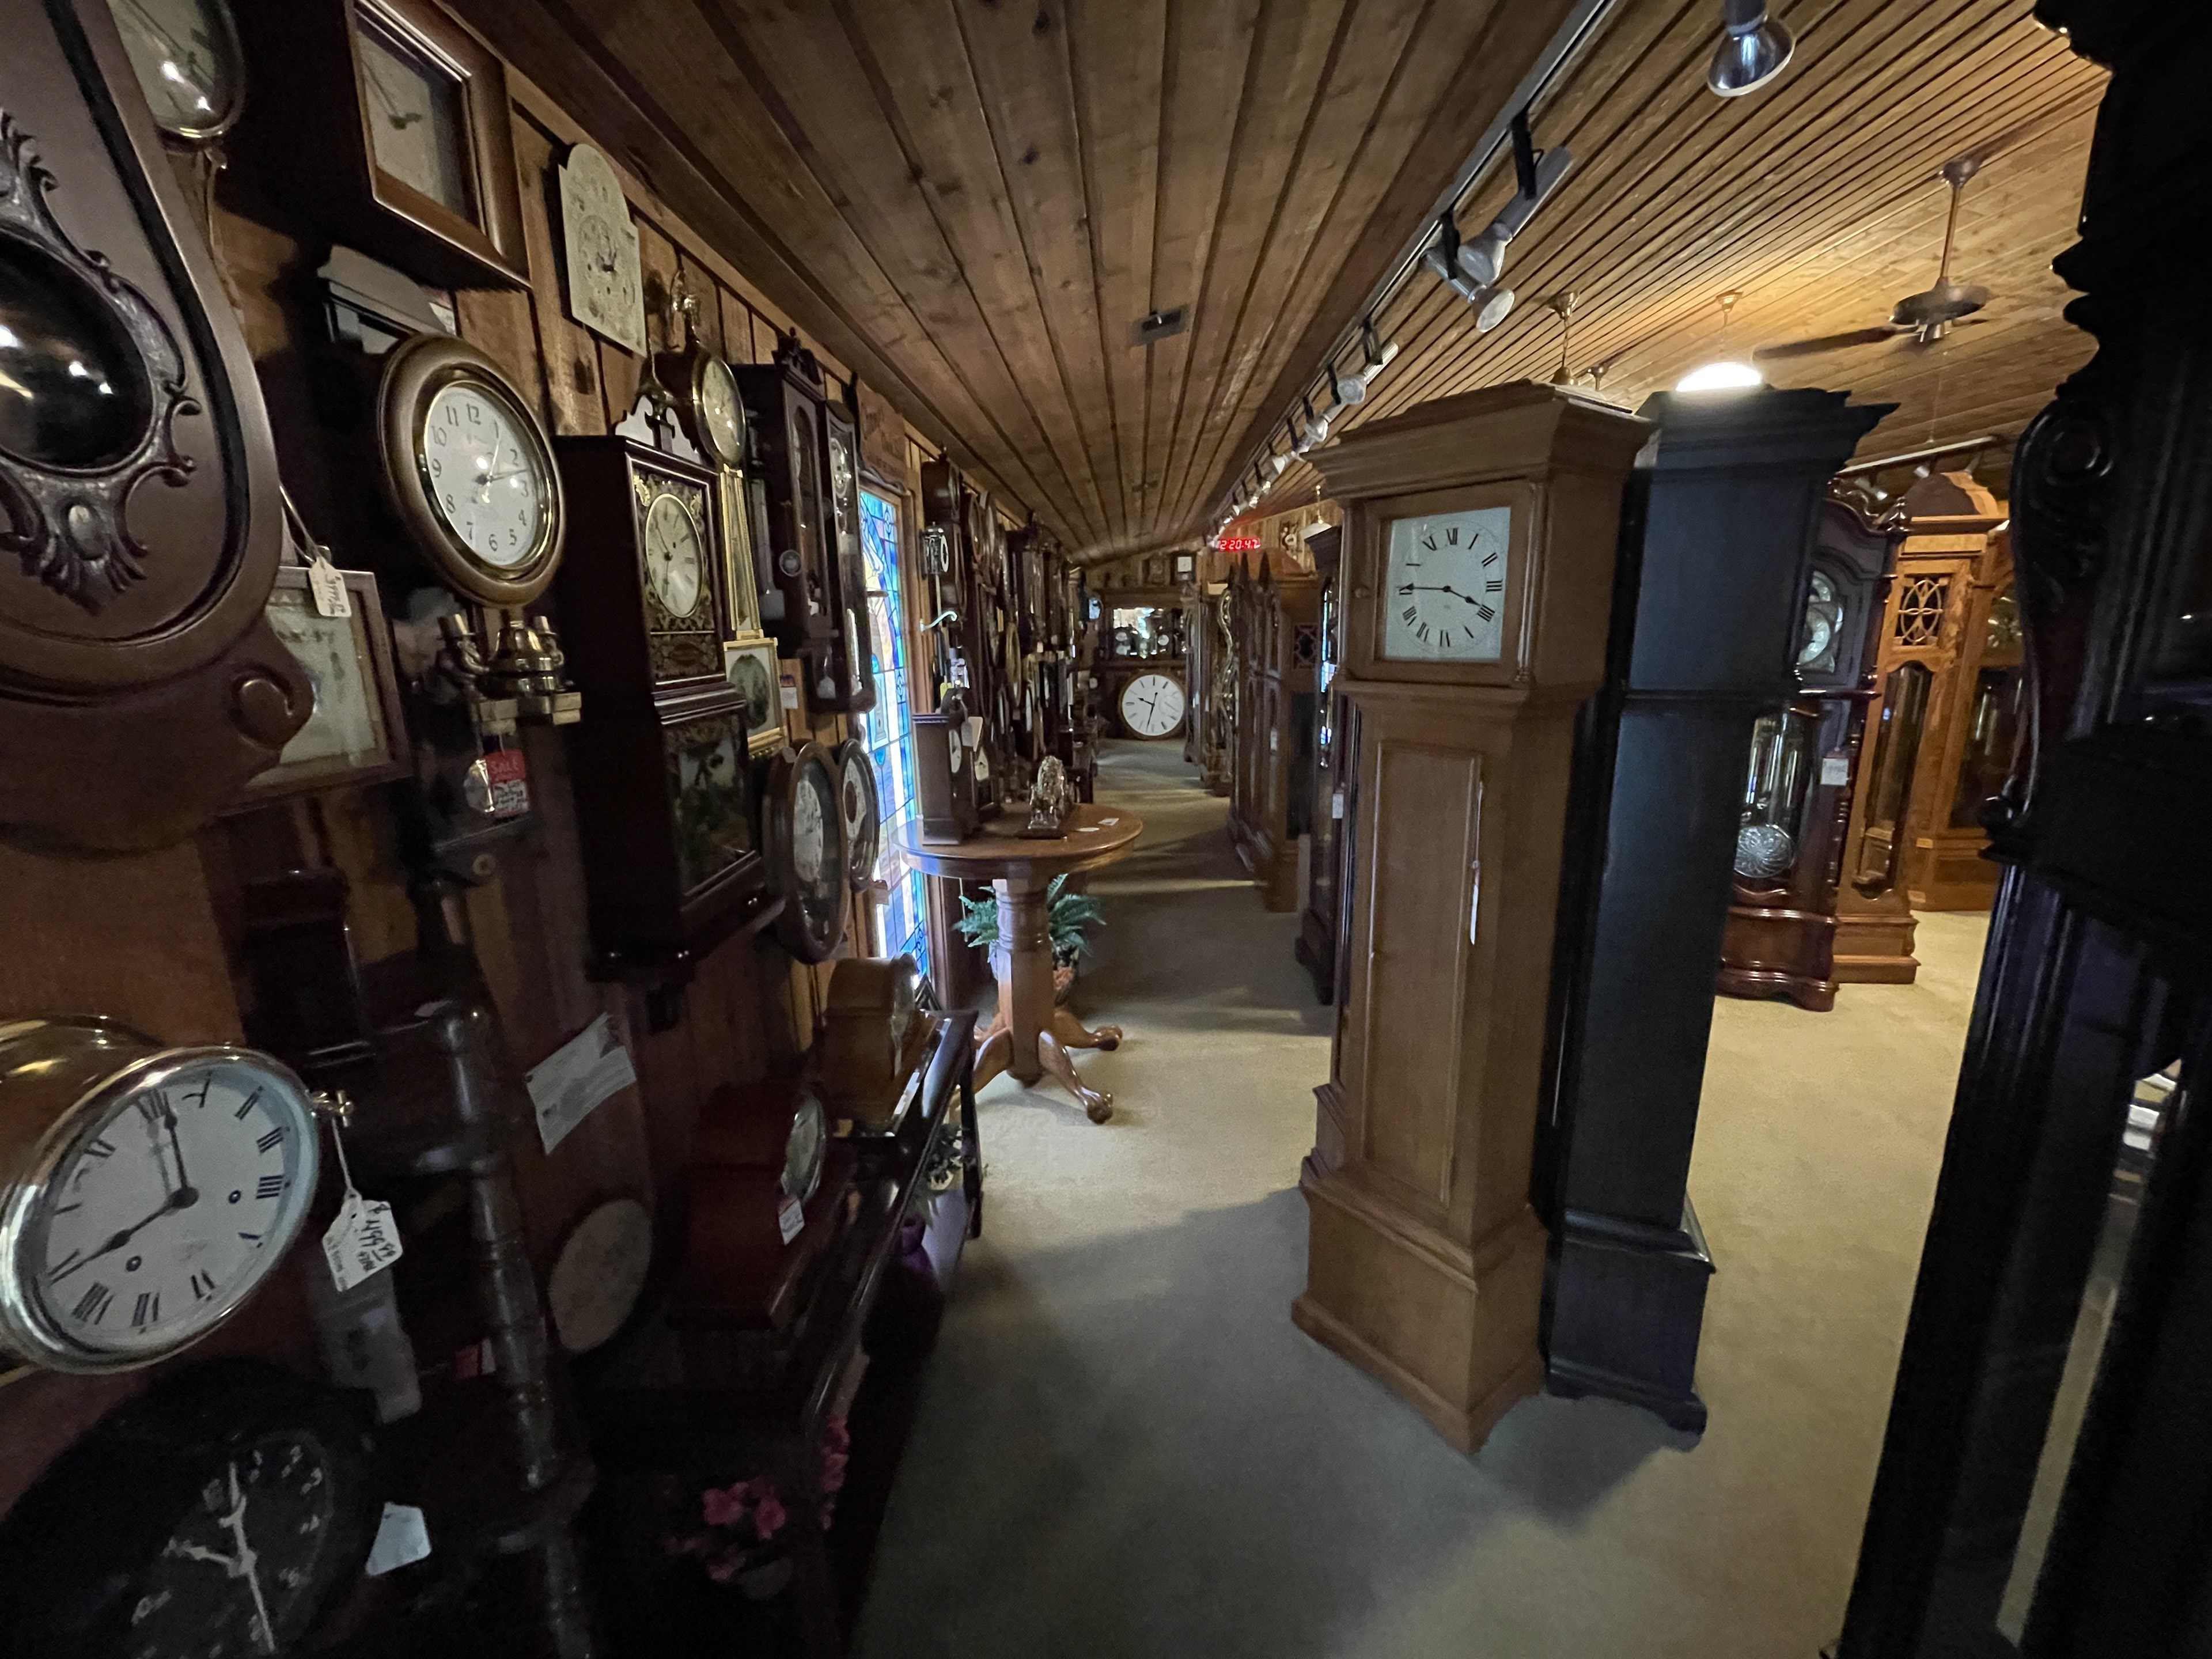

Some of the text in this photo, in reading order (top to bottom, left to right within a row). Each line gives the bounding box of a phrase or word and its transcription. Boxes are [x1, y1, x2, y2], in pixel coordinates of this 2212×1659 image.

[445, 406, 459, 426] 11
[466, 403, 481, 425] 12
[431, 425, 447, 446] 10
[432, 459, 442, 478] 9
[521, 480, 529, 498] 3
[446, 494, 456, 514] 8
[519, 509, 527, 527] 4
[466, 521, 474, 540] 7
[509, 528, 517, 546] 5
[488, 533, 498, 551] 6
